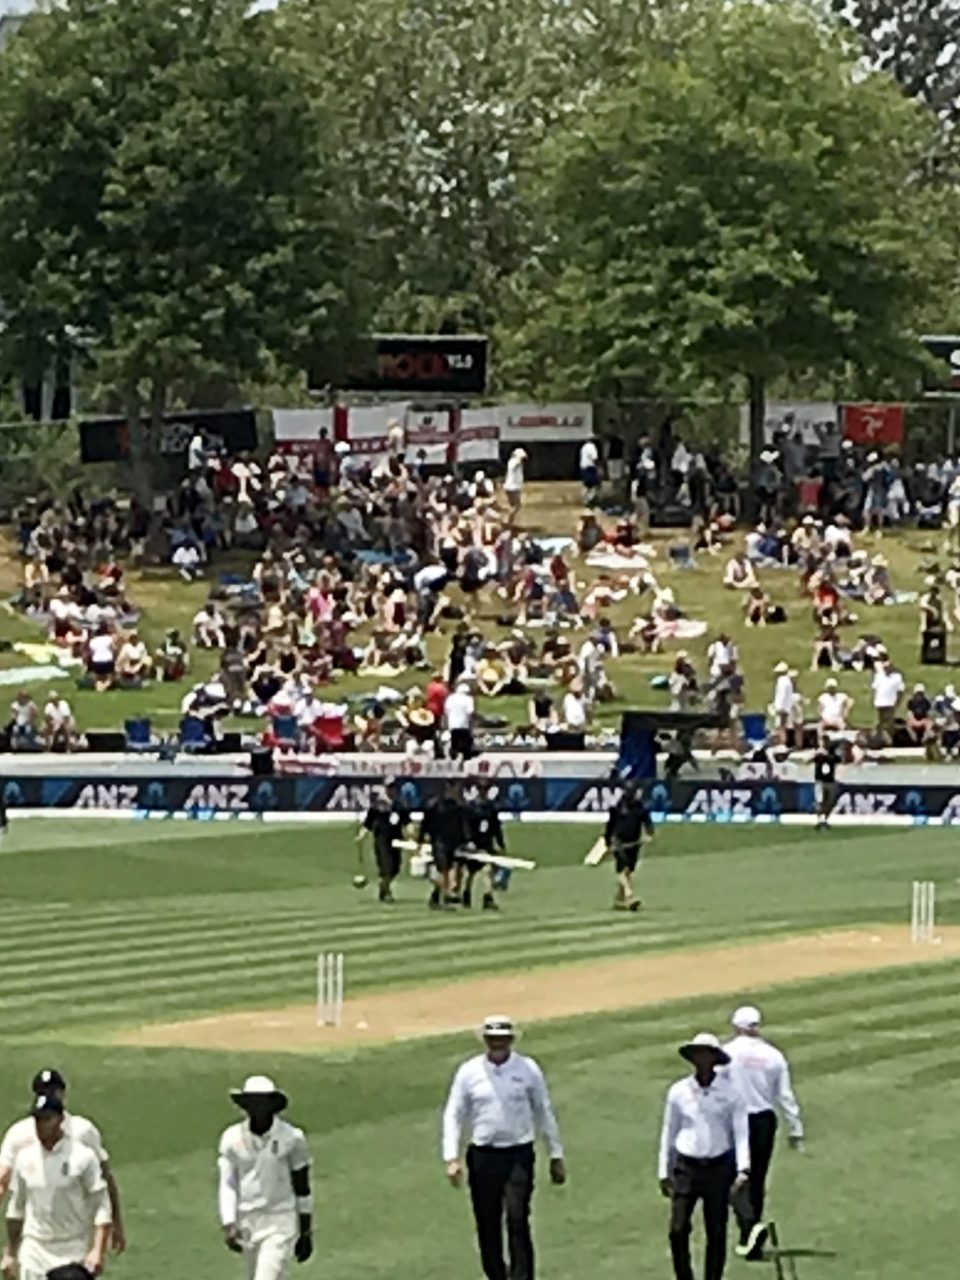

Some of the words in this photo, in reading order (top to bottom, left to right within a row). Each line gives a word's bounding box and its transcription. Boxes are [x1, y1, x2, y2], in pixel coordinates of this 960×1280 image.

[75, 784, 139, 809] ANZ
[183, 784, 249, 809] ANZ
[685, 788, 751, 814] ANZ
[835, 793, 897, 816] ANZ
